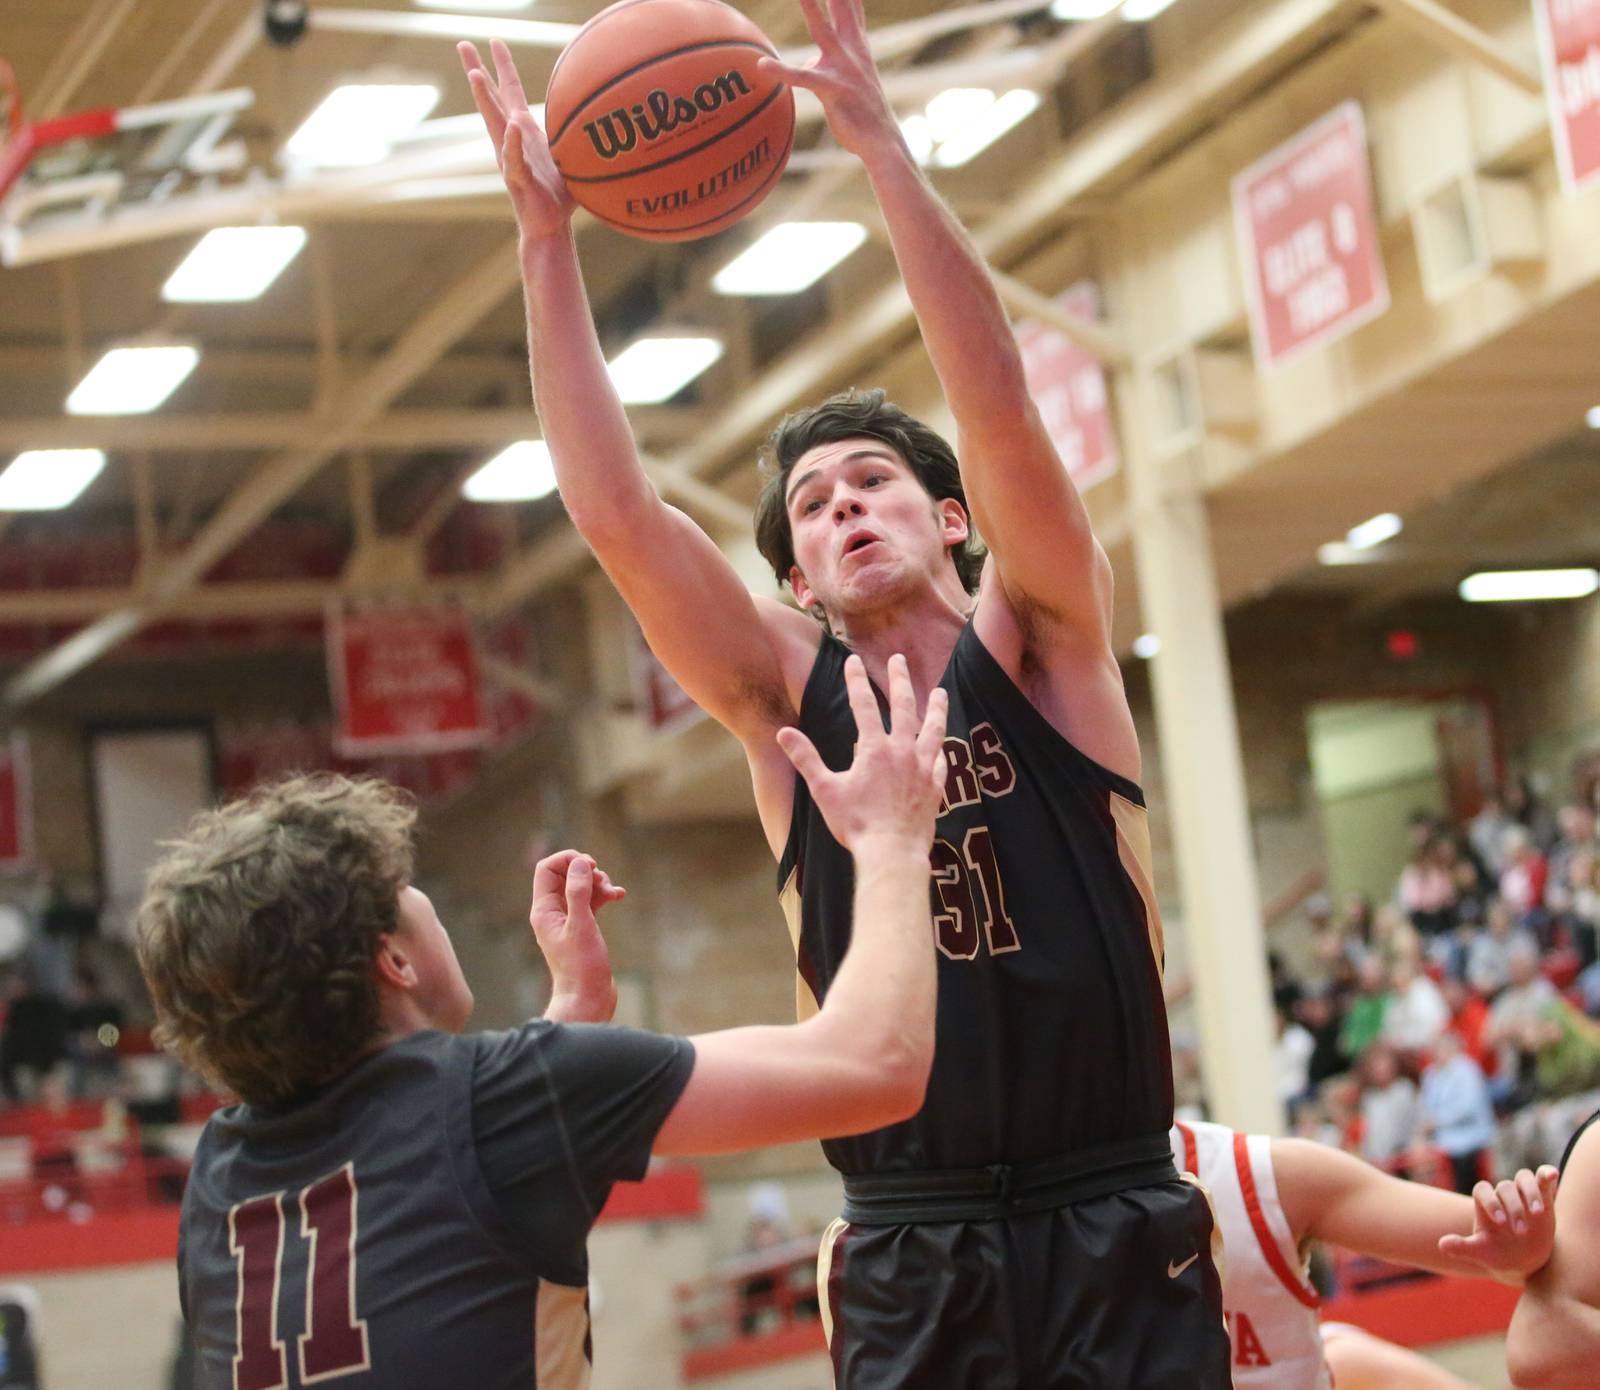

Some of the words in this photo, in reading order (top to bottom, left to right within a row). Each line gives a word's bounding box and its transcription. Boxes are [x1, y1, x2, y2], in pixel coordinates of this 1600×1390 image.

[583, 69, 752, 160] Wilson
[626, 137, 771, 216] EVOLUTION
[936, 721, 1017, 819] RS
[928, 826, 1022, 961] 31
[228, 1160, 371, 1390] 11
[1223, 1311, 1272, 1367] A
